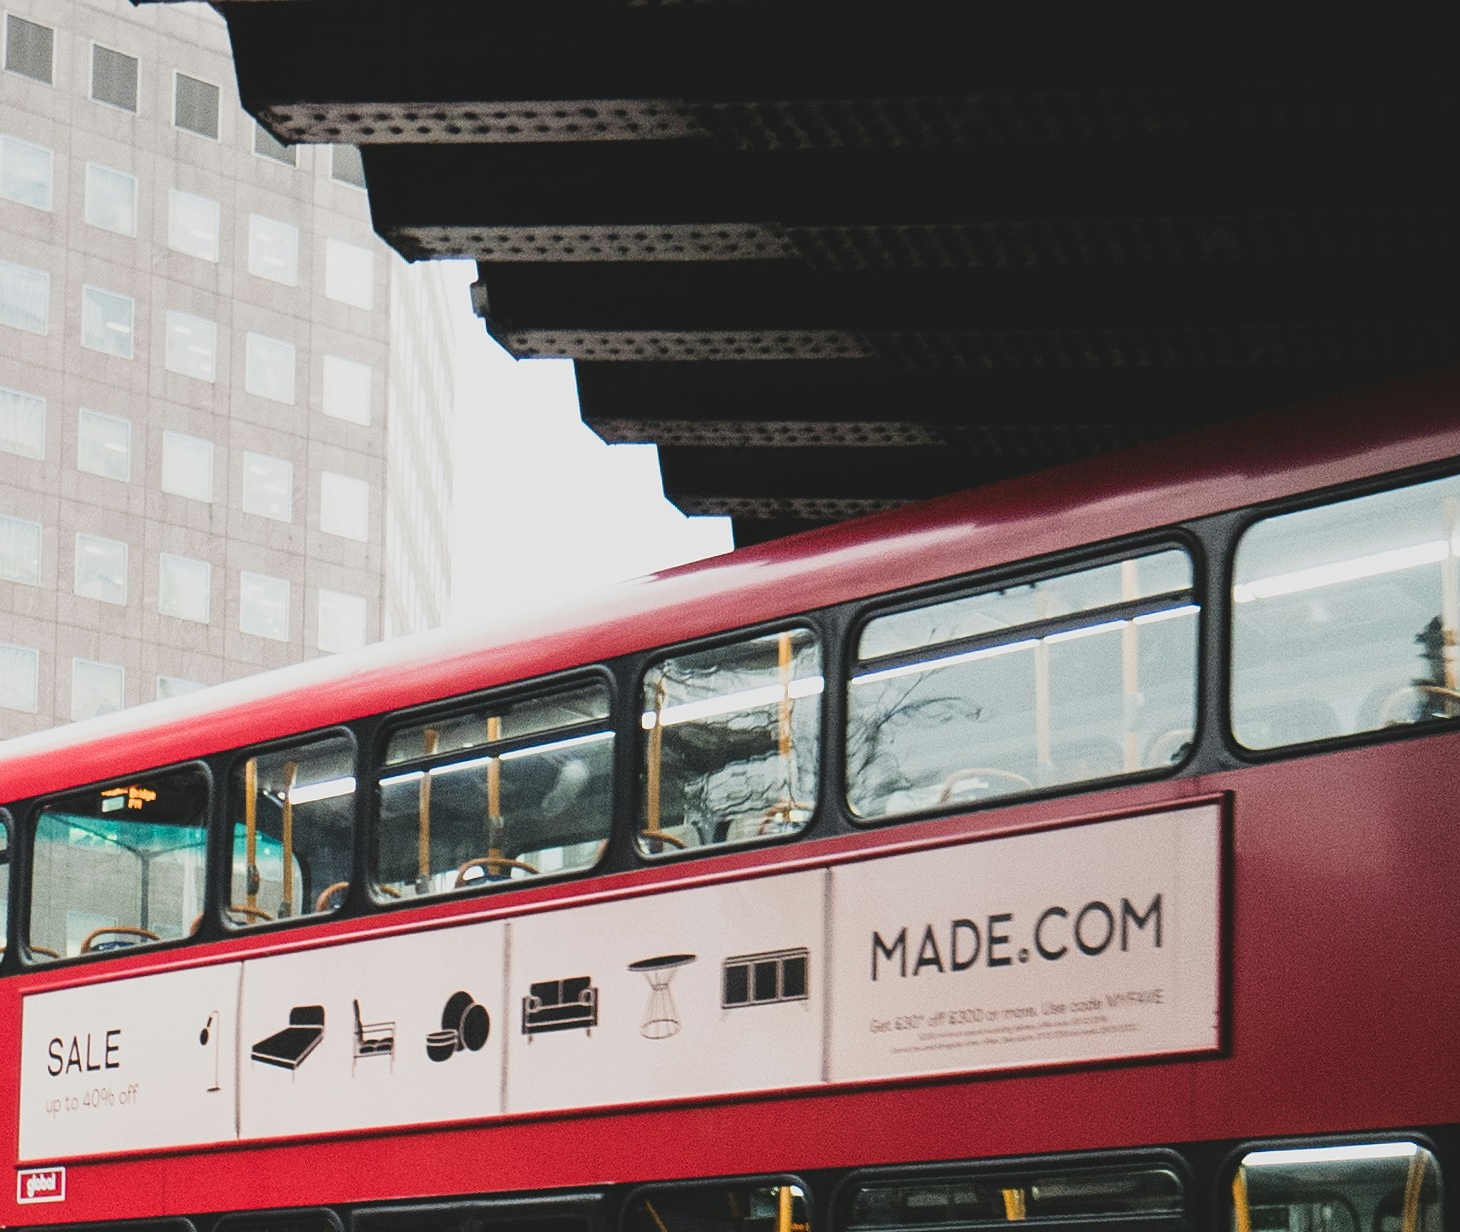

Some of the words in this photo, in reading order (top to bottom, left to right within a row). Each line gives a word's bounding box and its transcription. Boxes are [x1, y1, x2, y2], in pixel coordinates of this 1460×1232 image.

[870, 892, 1164, 982] MADE.COM
[46, 1028, 122, 1077] SALE
[45, 1096, 61, 1119] up
[64, 1092, 79, 1112] to
[82, 1087, 115, 1110] 40%
[118, 1083, 140, 1106] off
